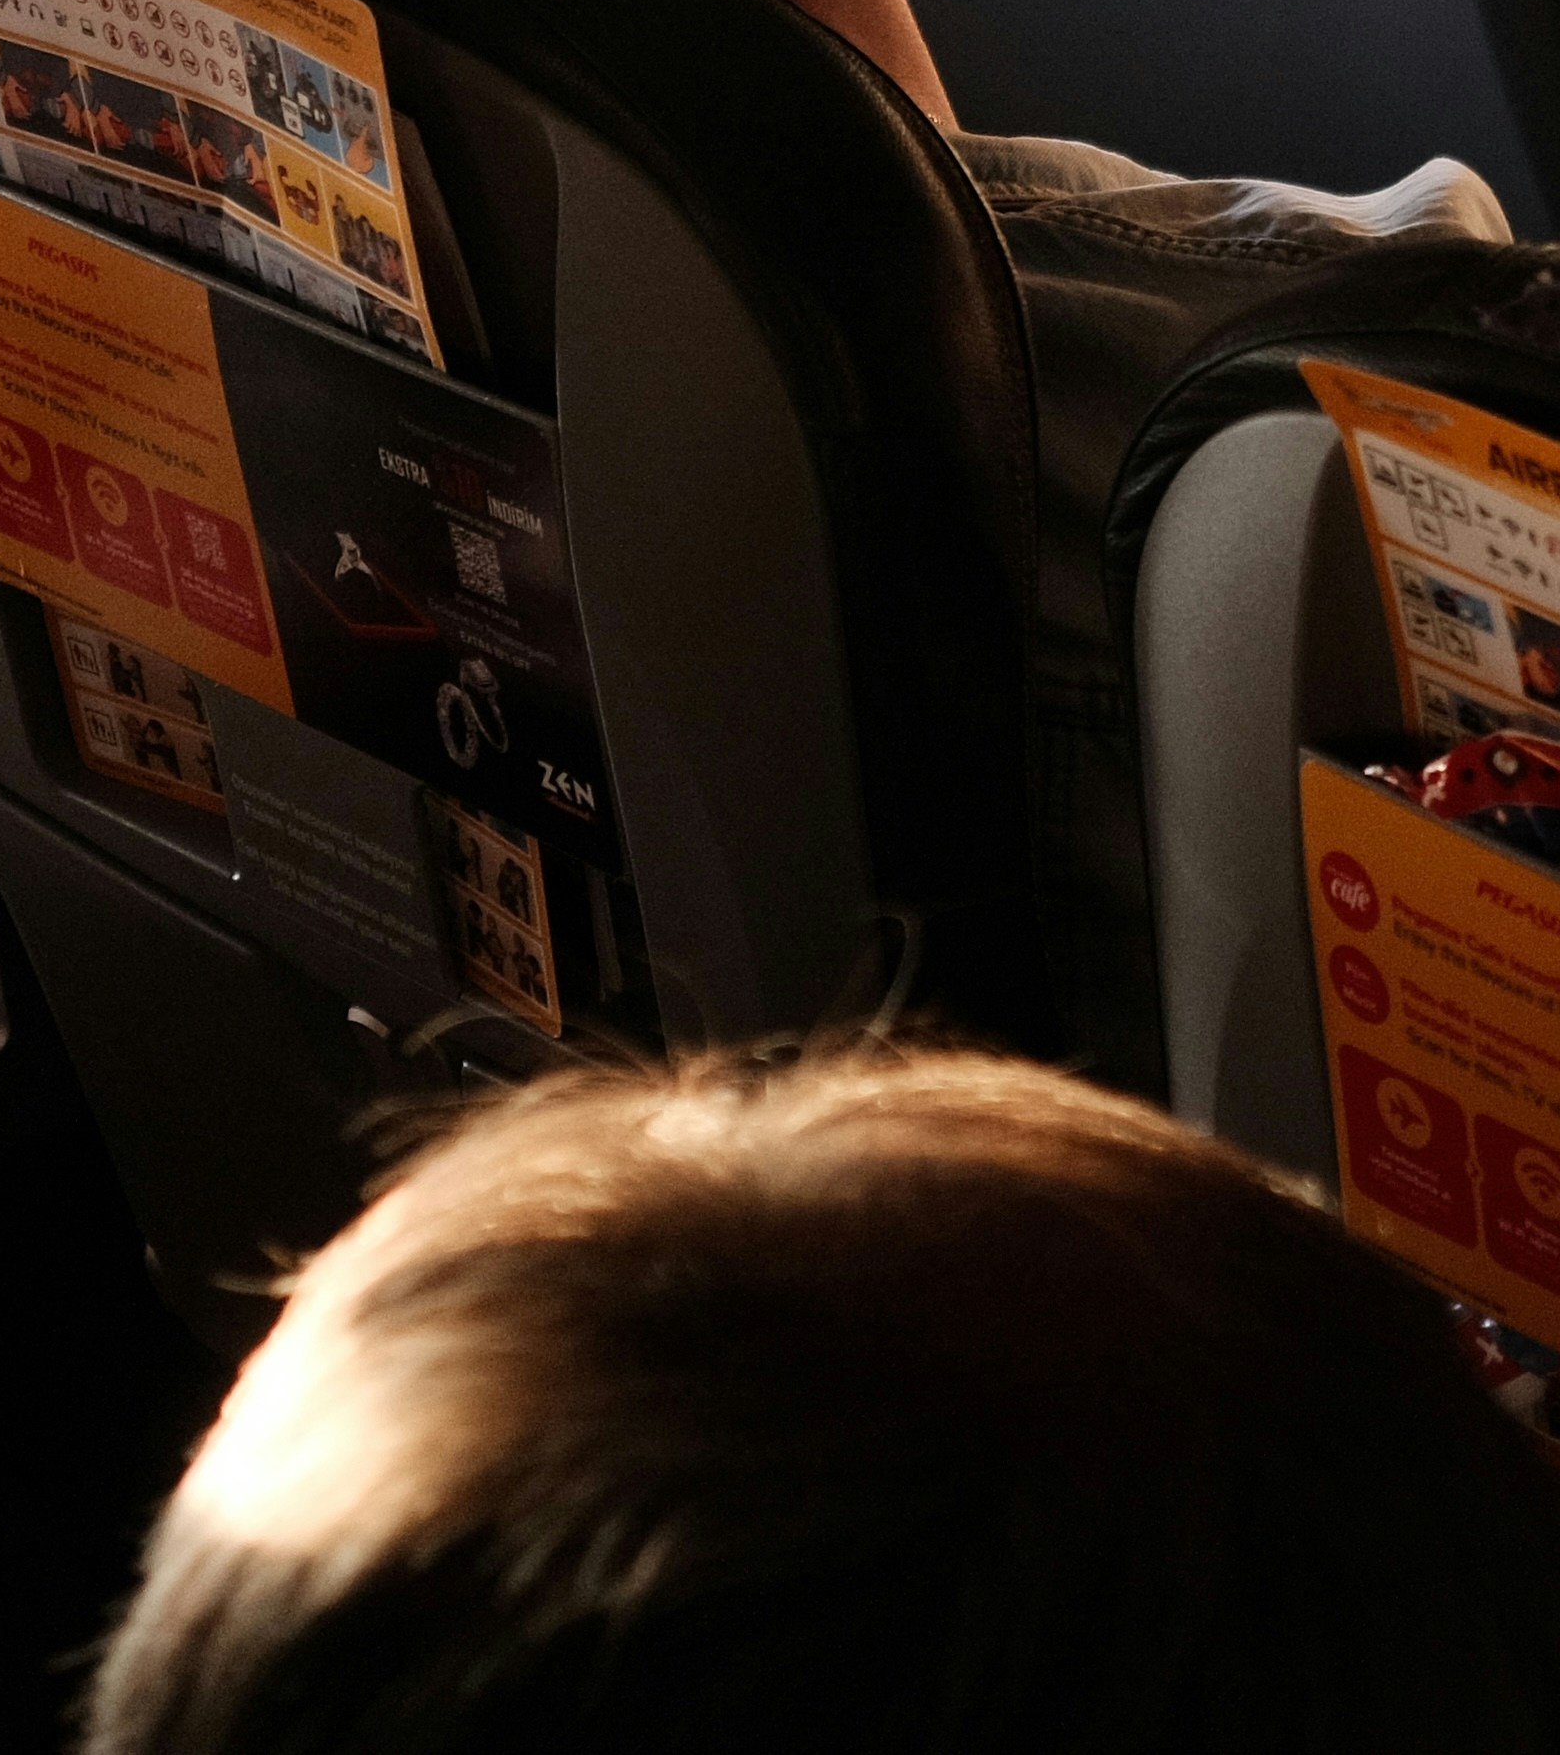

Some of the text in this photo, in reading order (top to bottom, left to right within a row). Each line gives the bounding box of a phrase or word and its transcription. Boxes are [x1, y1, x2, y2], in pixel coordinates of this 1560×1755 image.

[28, 237, 101, 284] PEGASUS
[378, 446, 430, 491] EKSTRA
[536, 758, 596, 813] ZEN
